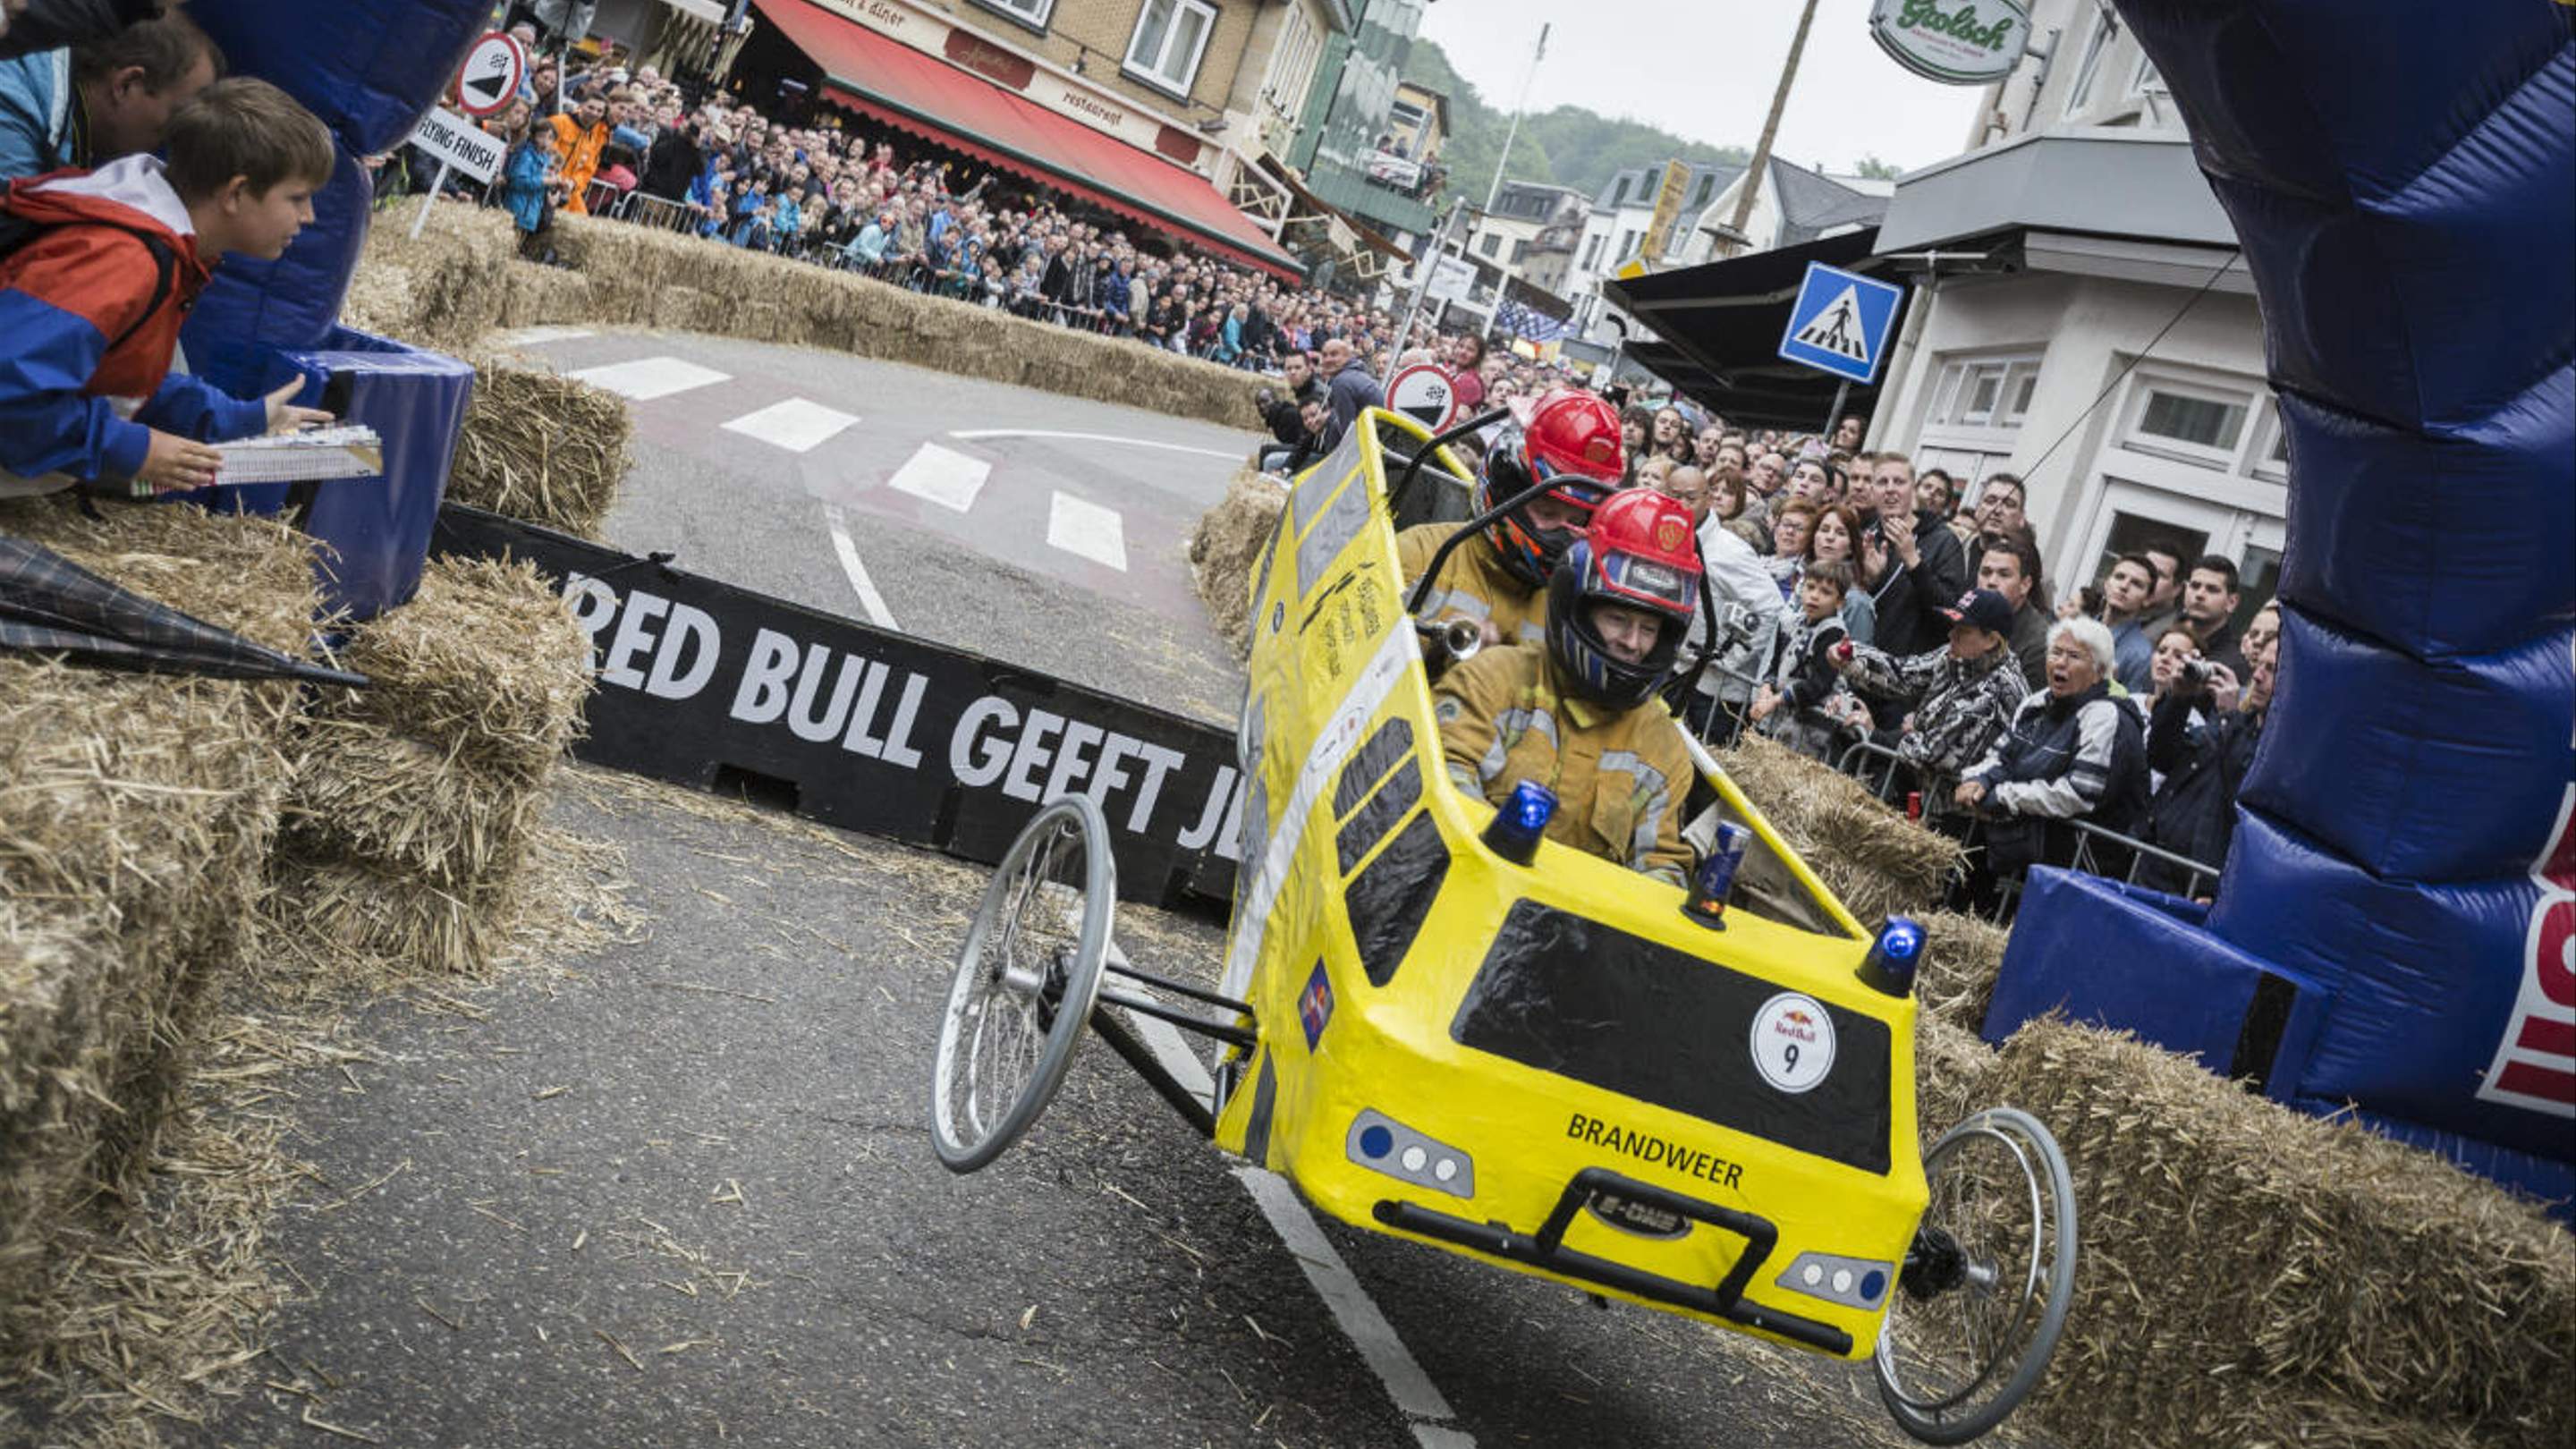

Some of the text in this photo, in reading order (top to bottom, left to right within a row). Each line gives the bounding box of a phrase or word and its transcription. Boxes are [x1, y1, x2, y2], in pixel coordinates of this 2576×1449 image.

[1896, 0, 2014, 51] Grolsch
[1062, 91, 1123, 125] restaurant
[417, 118, 497, 173] FLYING FINISH
[559, 571, 722, 700] RED
[730, 626, 930, 769] BULL
[949, 695, 1186, 834] GEEFT
[1784, 1045, 1800, 1073] 9
[1566, 1112, 1744, 1191] BRANDWEER
